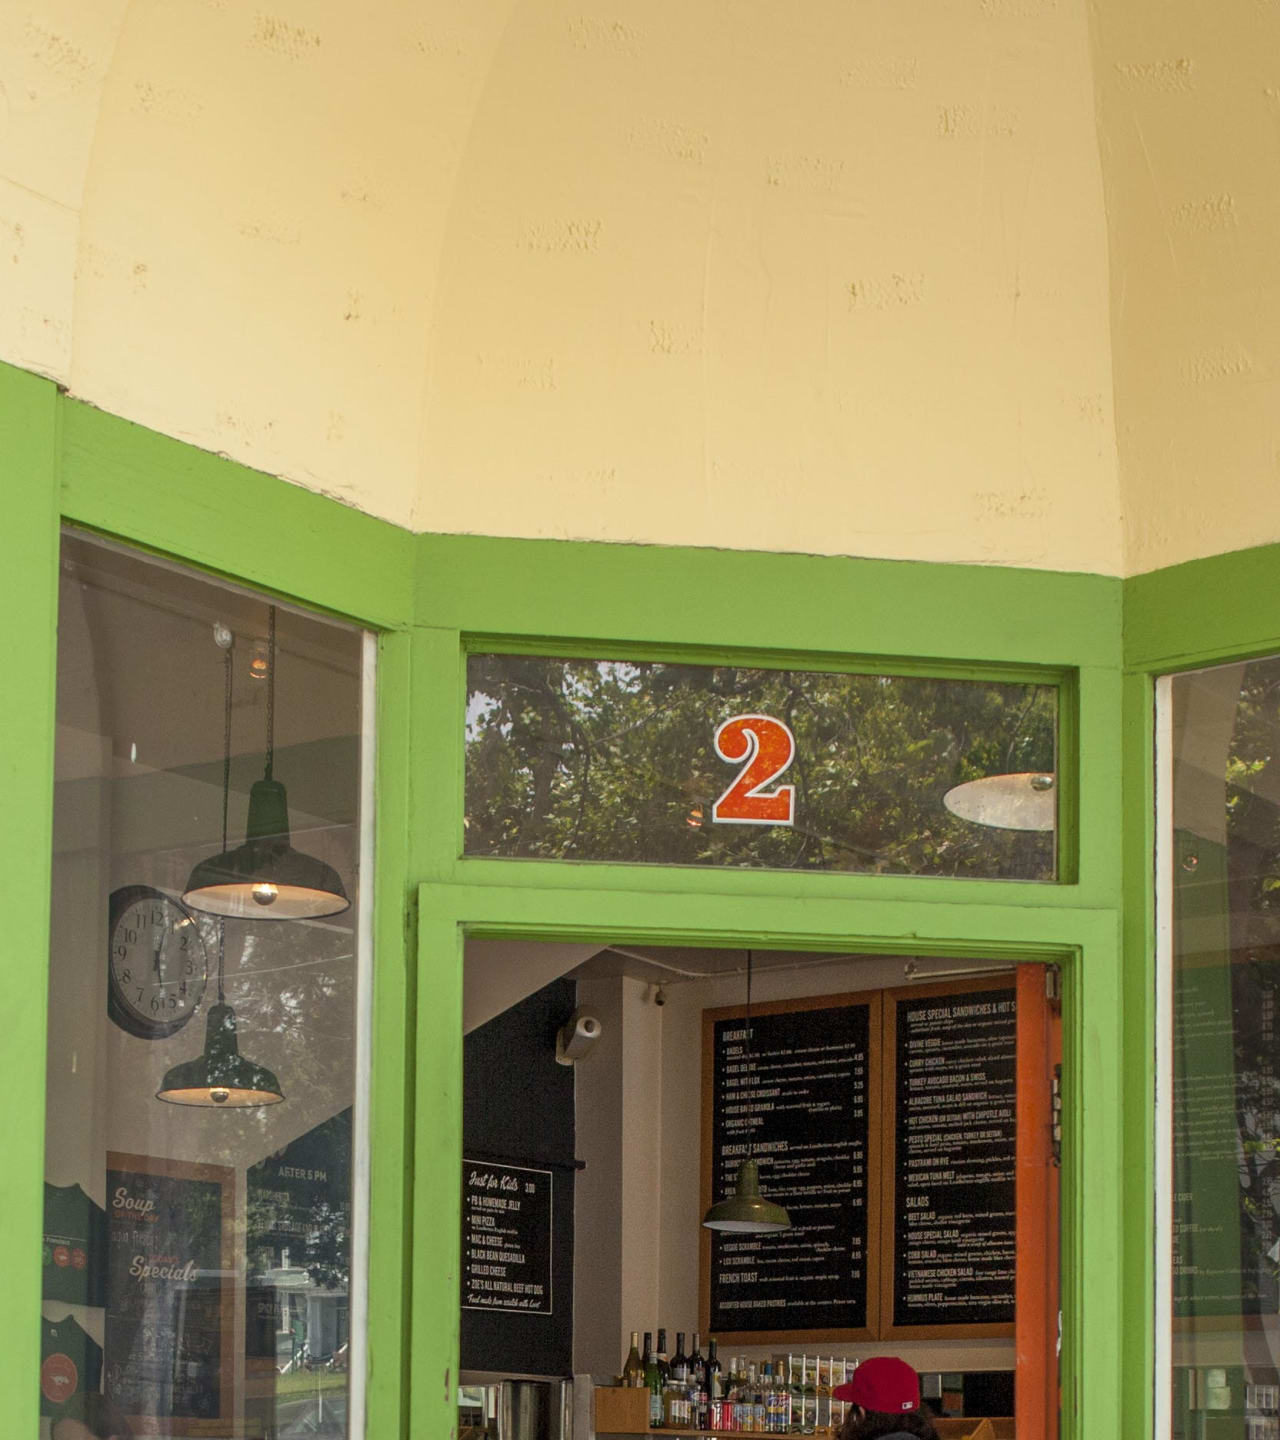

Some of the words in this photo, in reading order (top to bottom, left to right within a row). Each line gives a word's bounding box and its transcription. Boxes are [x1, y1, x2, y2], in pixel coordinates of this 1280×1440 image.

[712, 713, 795, 826] 2
[723, 1028, 753, 1042] BREAKFAT
[278, 1166, 305, 1181] AFTER
[314, 1170, 327, 1183] PM
[500, 1175, 519, 1191] Kids
[112, 1187, 154, 1217] Soup
[129, 1255, 199, 1281] Specials
